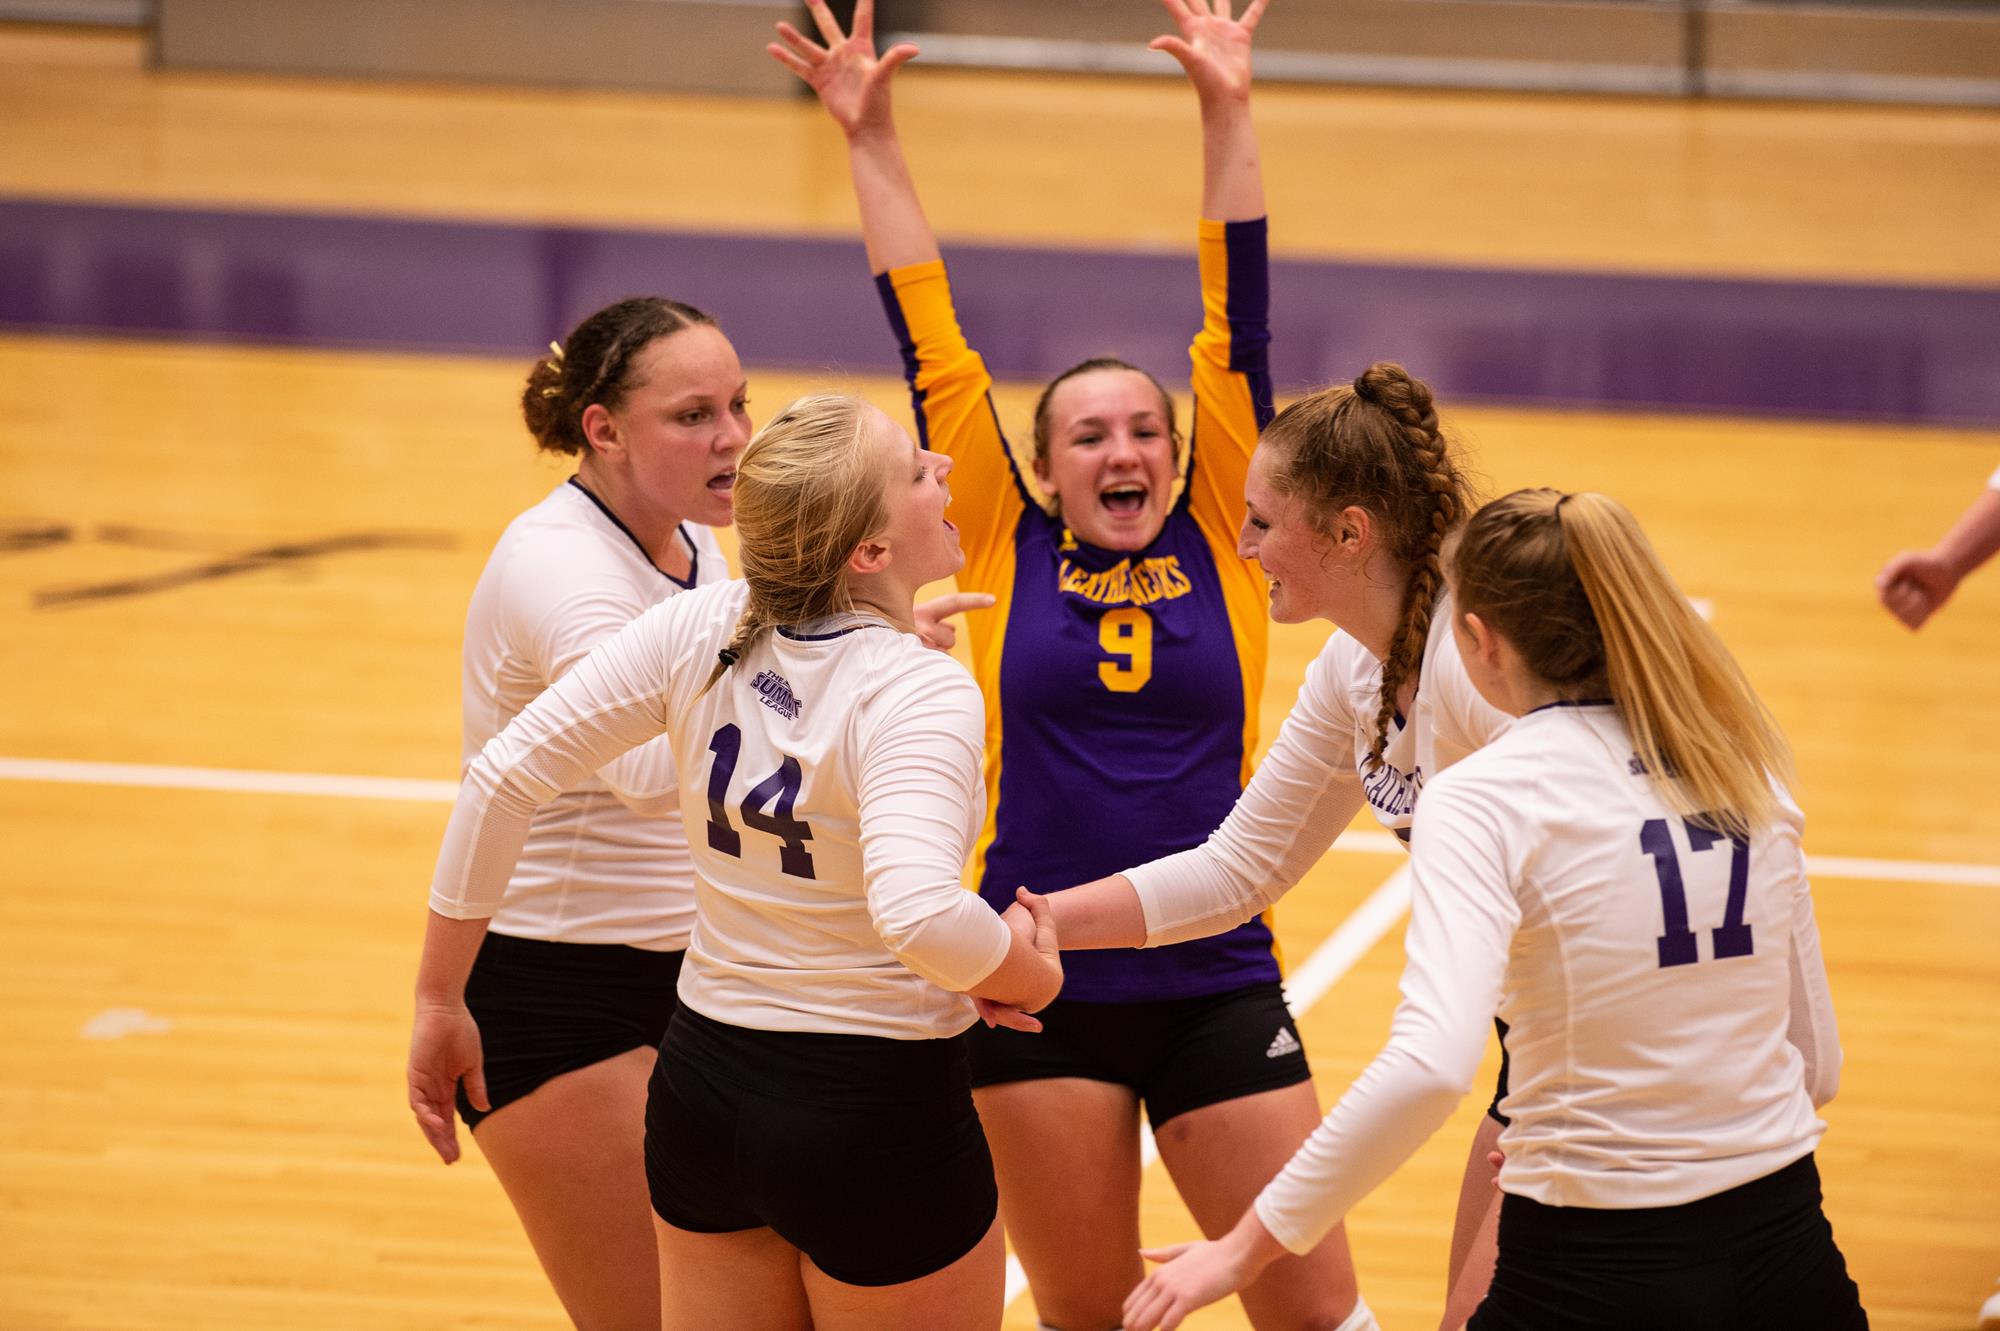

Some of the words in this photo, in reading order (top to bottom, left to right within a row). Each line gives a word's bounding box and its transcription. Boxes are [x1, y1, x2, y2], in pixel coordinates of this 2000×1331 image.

[767, 669, 784, 684] THE
[1098, 607, 1153, 693] 9
[760, 696, 793, 721] LEAGUE
[706, 722, 816, 880] 14
[1639, 809, 1754, 968] 17
